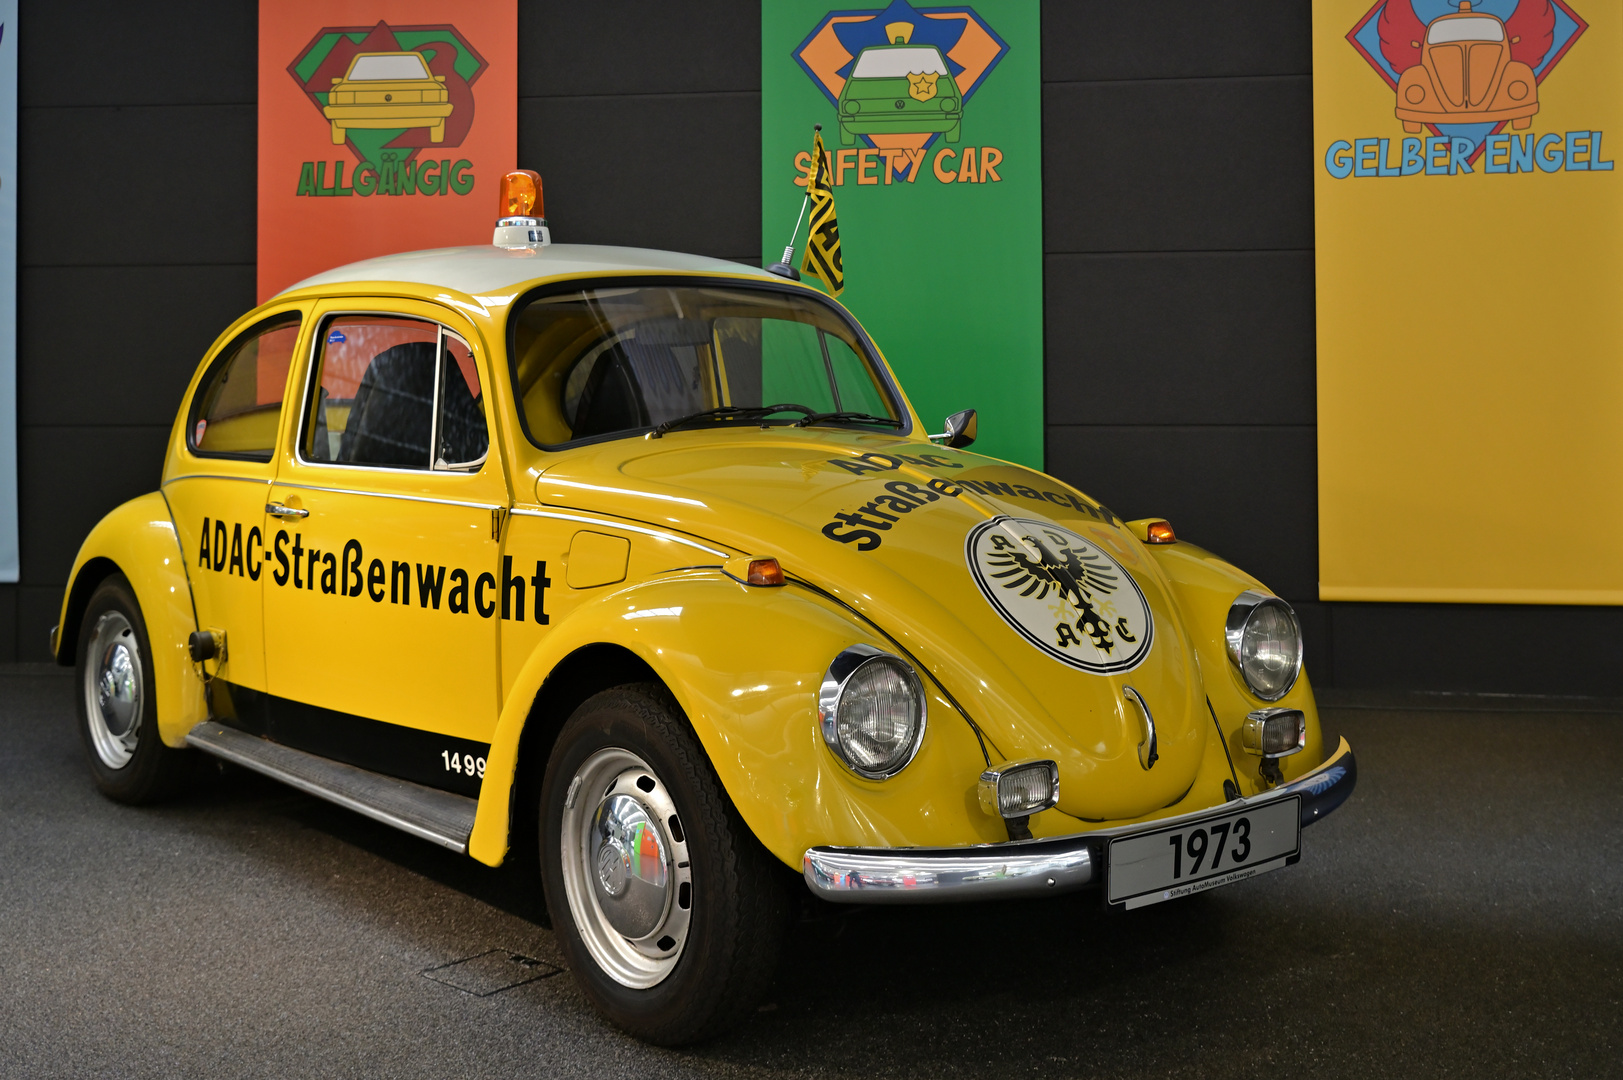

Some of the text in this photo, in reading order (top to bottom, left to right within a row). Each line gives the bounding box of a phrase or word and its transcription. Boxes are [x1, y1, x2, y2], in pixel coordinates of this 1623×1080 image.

[296, 152, 475, 197] ALLGÄNGIG
[932, 146, 1004, 184] CAR
[1325, 130, 1615, 180] GELBER ENGEL
[827, 453, 964, 476] ADAC
[821, 478, 1121, 551] Straßenwacht
[198, 517, 552, 626] ADAC-Straßenwacht
[1169, 817, 1251, 879] 1973
[1170, 869, 1256, 897] Stiftung AutoMuseum Volkswagen
